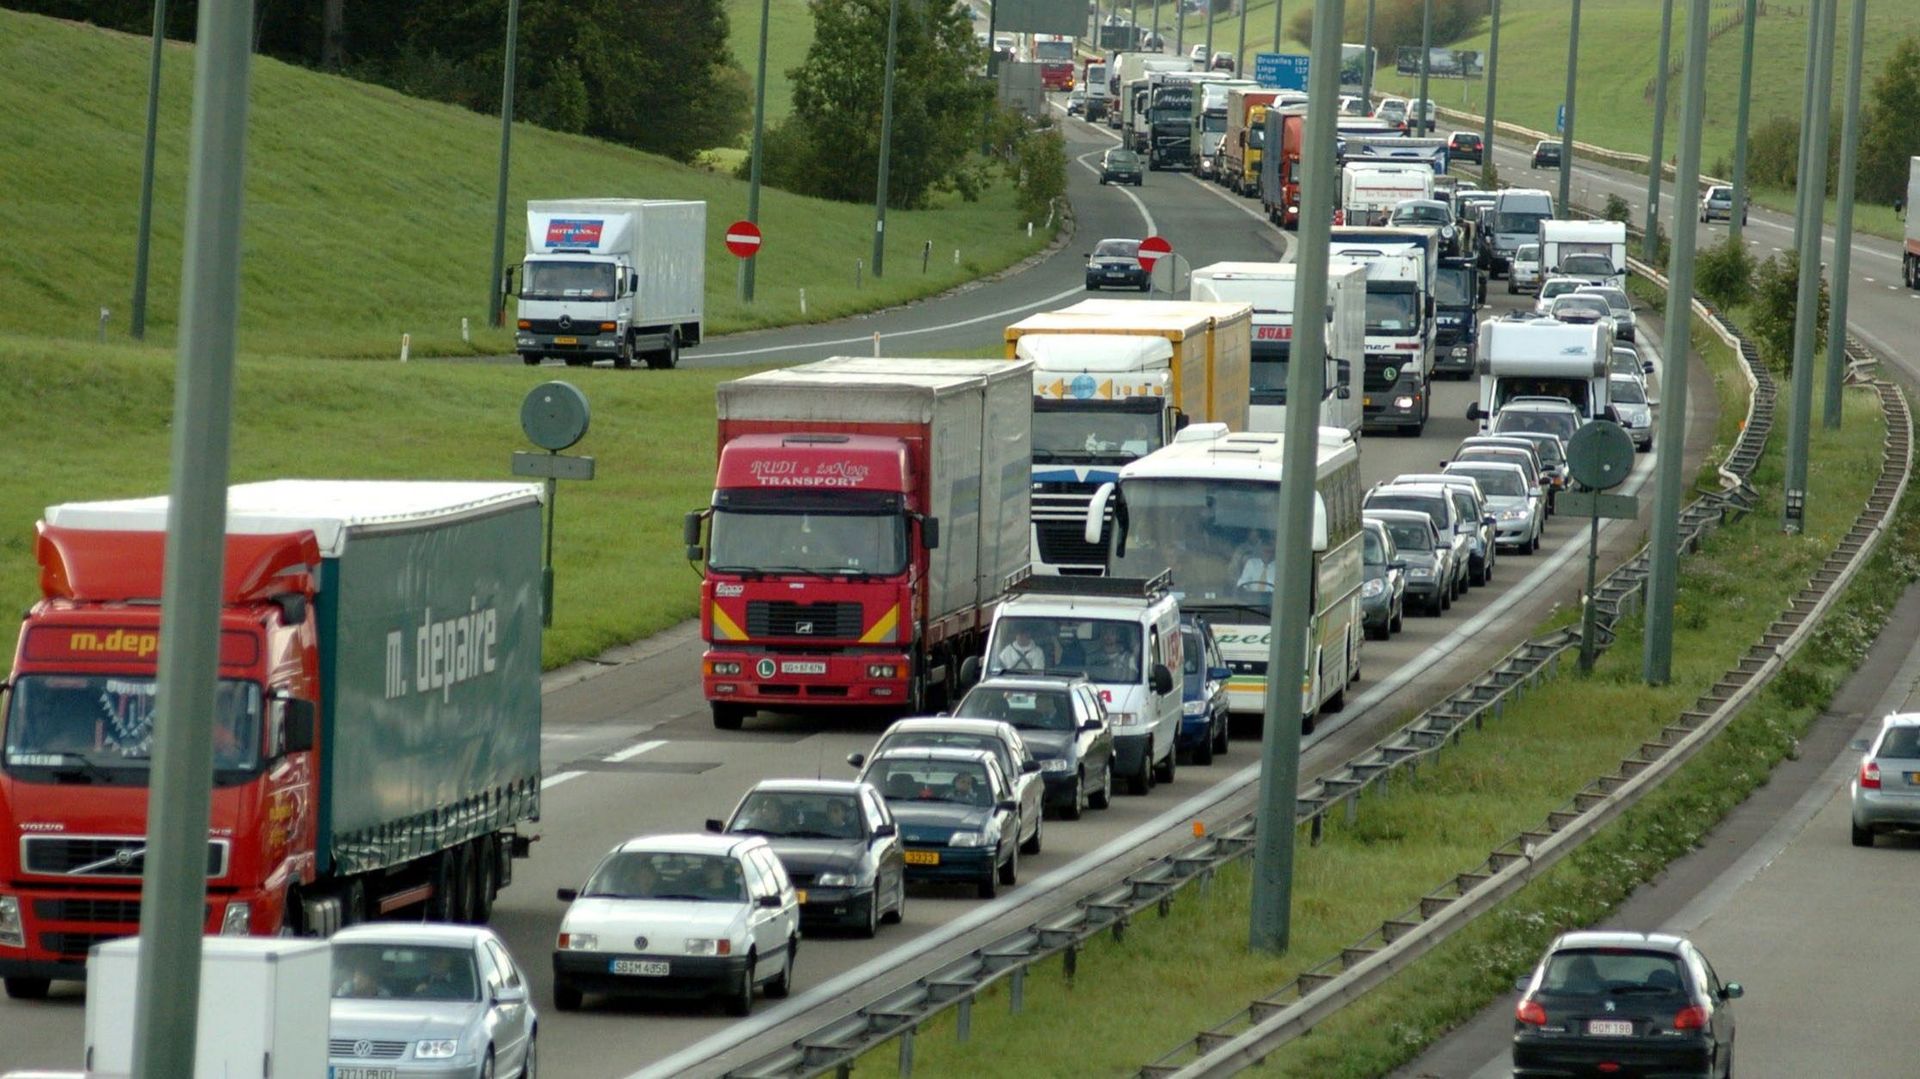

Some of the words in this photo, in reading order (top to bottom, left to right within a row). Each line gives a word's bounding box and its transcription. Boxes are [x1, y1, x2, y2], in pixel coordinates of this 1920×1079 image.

[757, 475, 864, 486] TRANSPORT
[70, 629, 158, 657] m.dep
[416, 596, 496, 704] depaire
[20, 823, 64, 831] VOLVO
